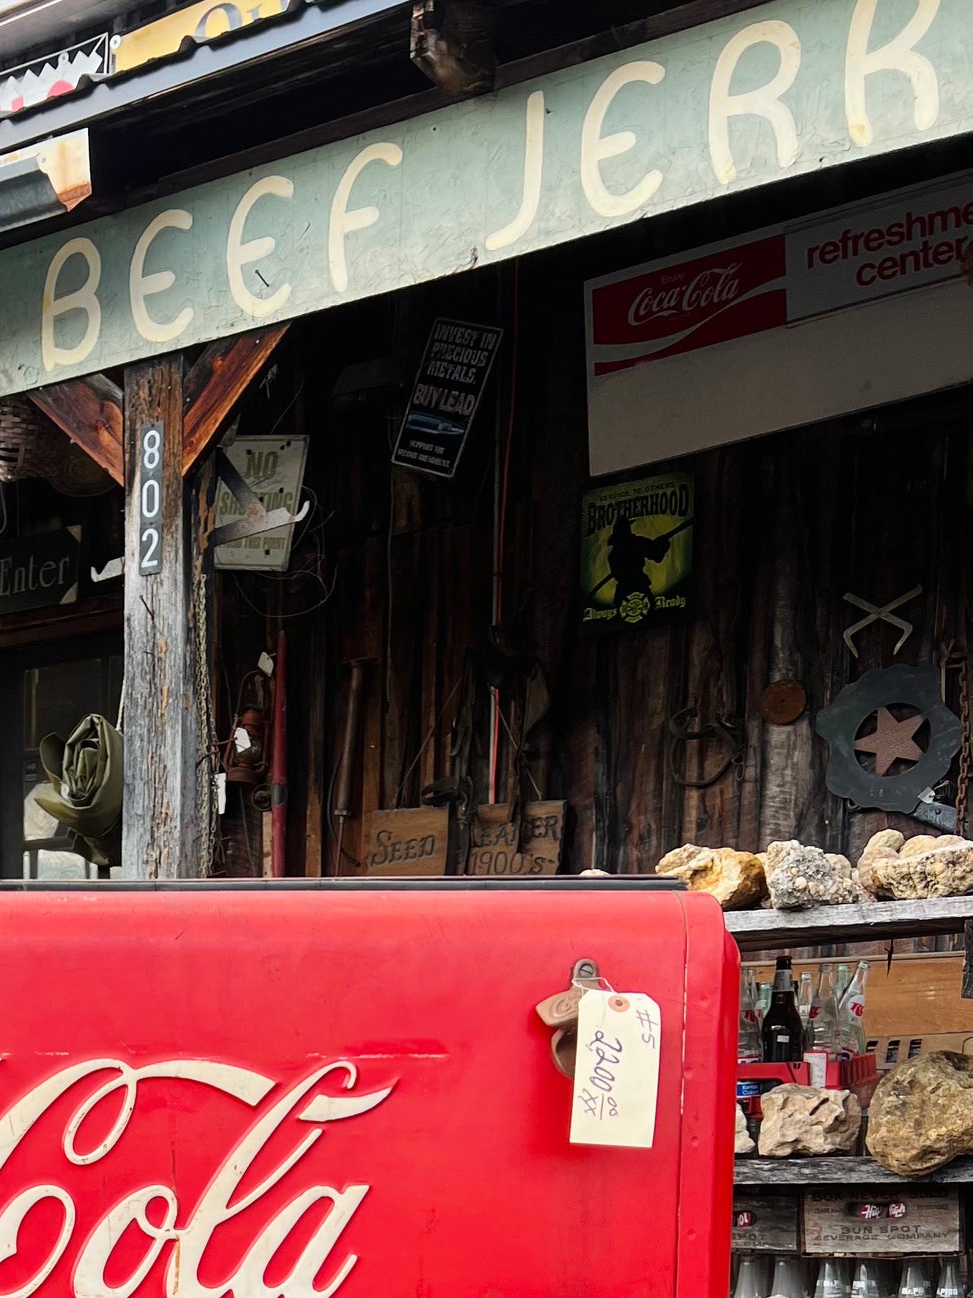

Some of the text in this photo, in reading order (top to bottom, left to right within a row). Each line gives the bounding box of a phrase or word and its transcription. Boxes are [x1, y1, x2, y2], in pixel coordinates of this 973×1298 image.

[42, 143, 403, 371] BEEF
[627, 262, 744, 327] Coca-Cola
[434, 323, 497, 350] INVEST IN
[431, 341, 489, 367] PRECIOUS
[413, 384, 477, 417] BUY LEAD
[246, 451, 279, 479] NO
[220, 491, 293, 516] SHTING
[587, 484, 690, 537] BROTHERHOOD
[470, 815, 560, 848] LEAER
[880, 1224, 922, 1234] SPOT
[887, 1231, 949, 1241] COMPANY
